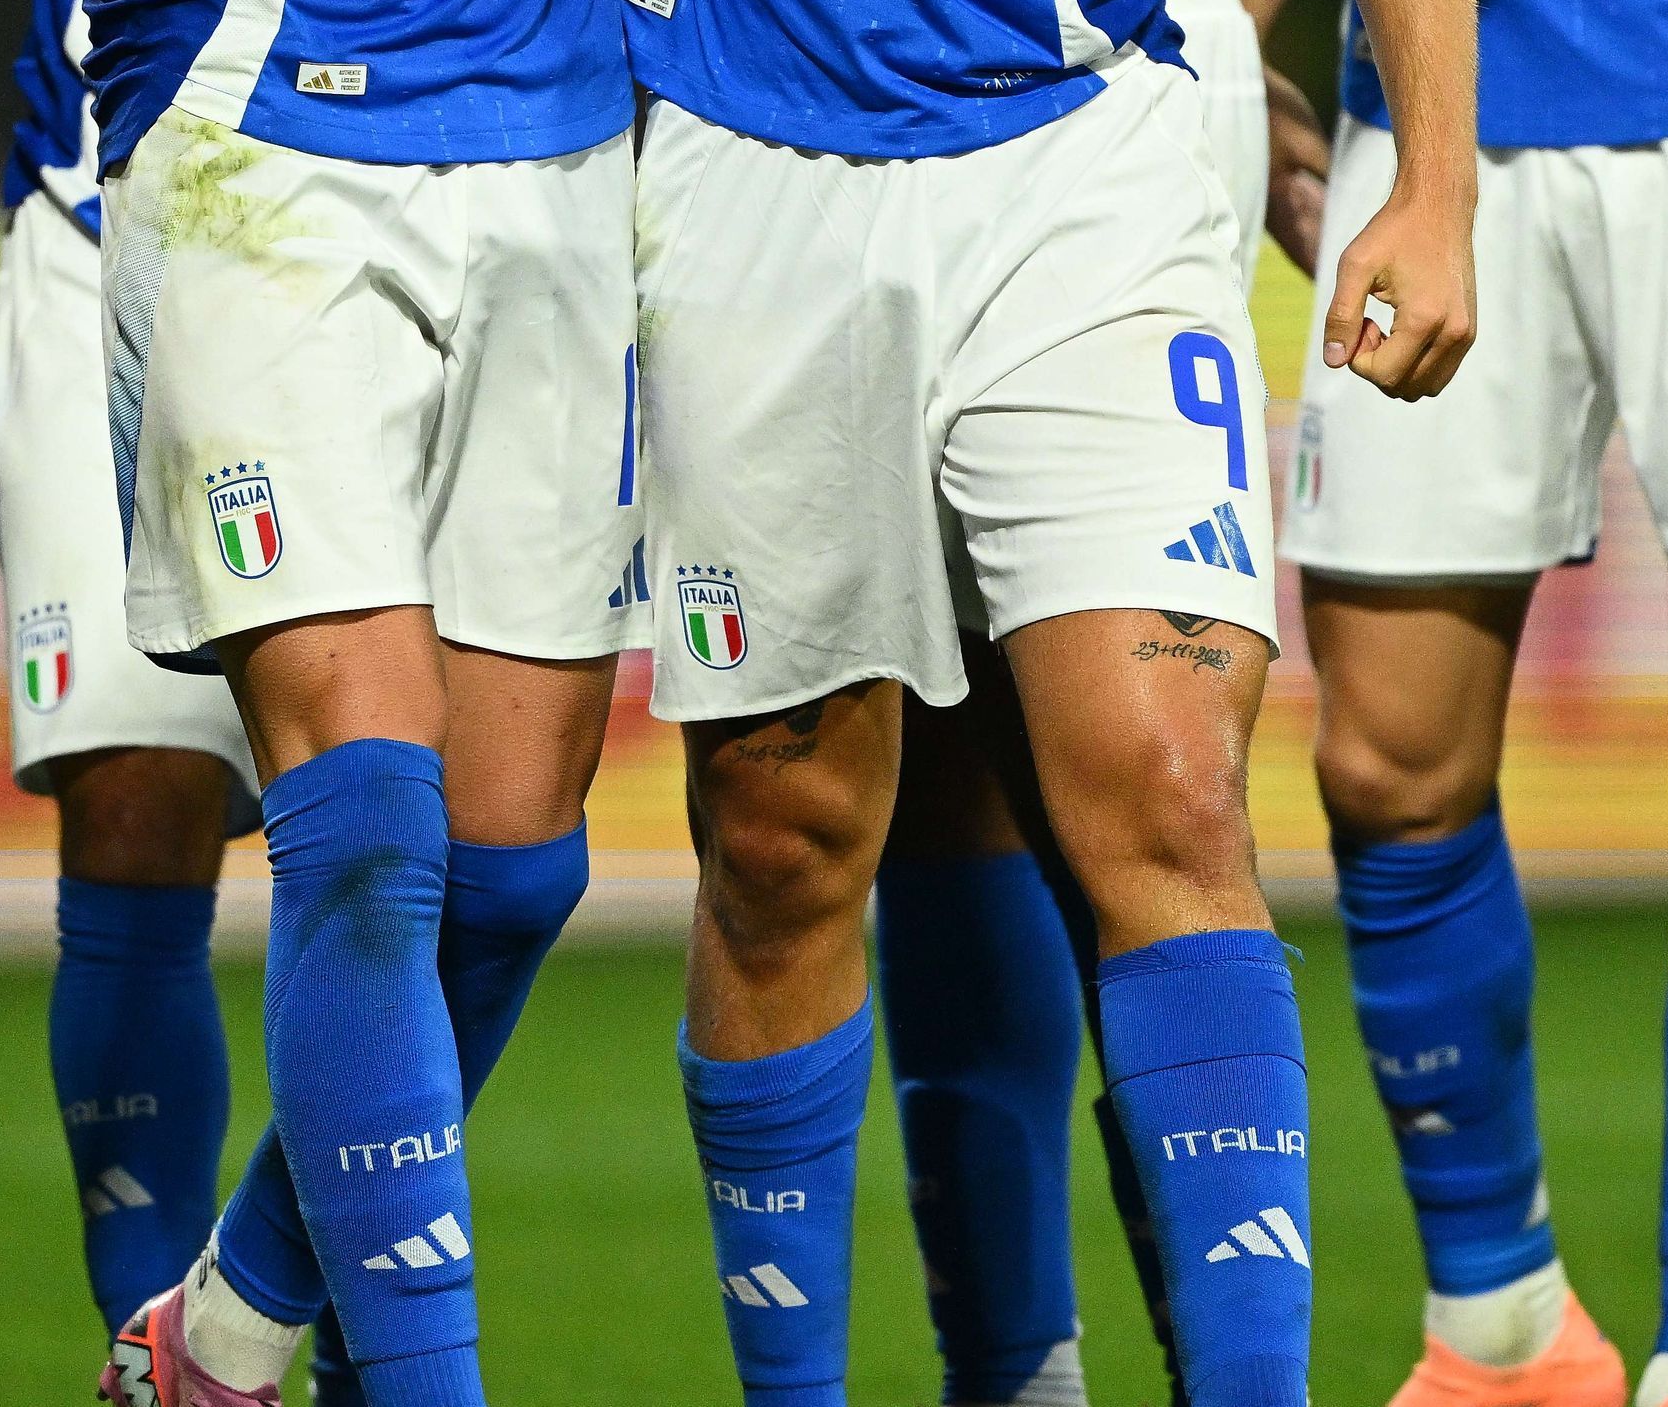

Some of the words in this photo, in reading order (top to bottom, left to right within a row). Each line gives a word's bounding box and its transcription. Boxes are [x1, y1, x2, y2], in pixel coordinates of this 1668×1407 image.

[1168, 331, 1249, 491] 9
[214, 485, 267, 514] ITALIA
[684, 587, 734, 606] ITALIA
[339, 1123, 461, 1172] ITALIA
[1162, 1128, 1305, 1161] ITALIA
[713, 1180, 806, 1213] ALIA
